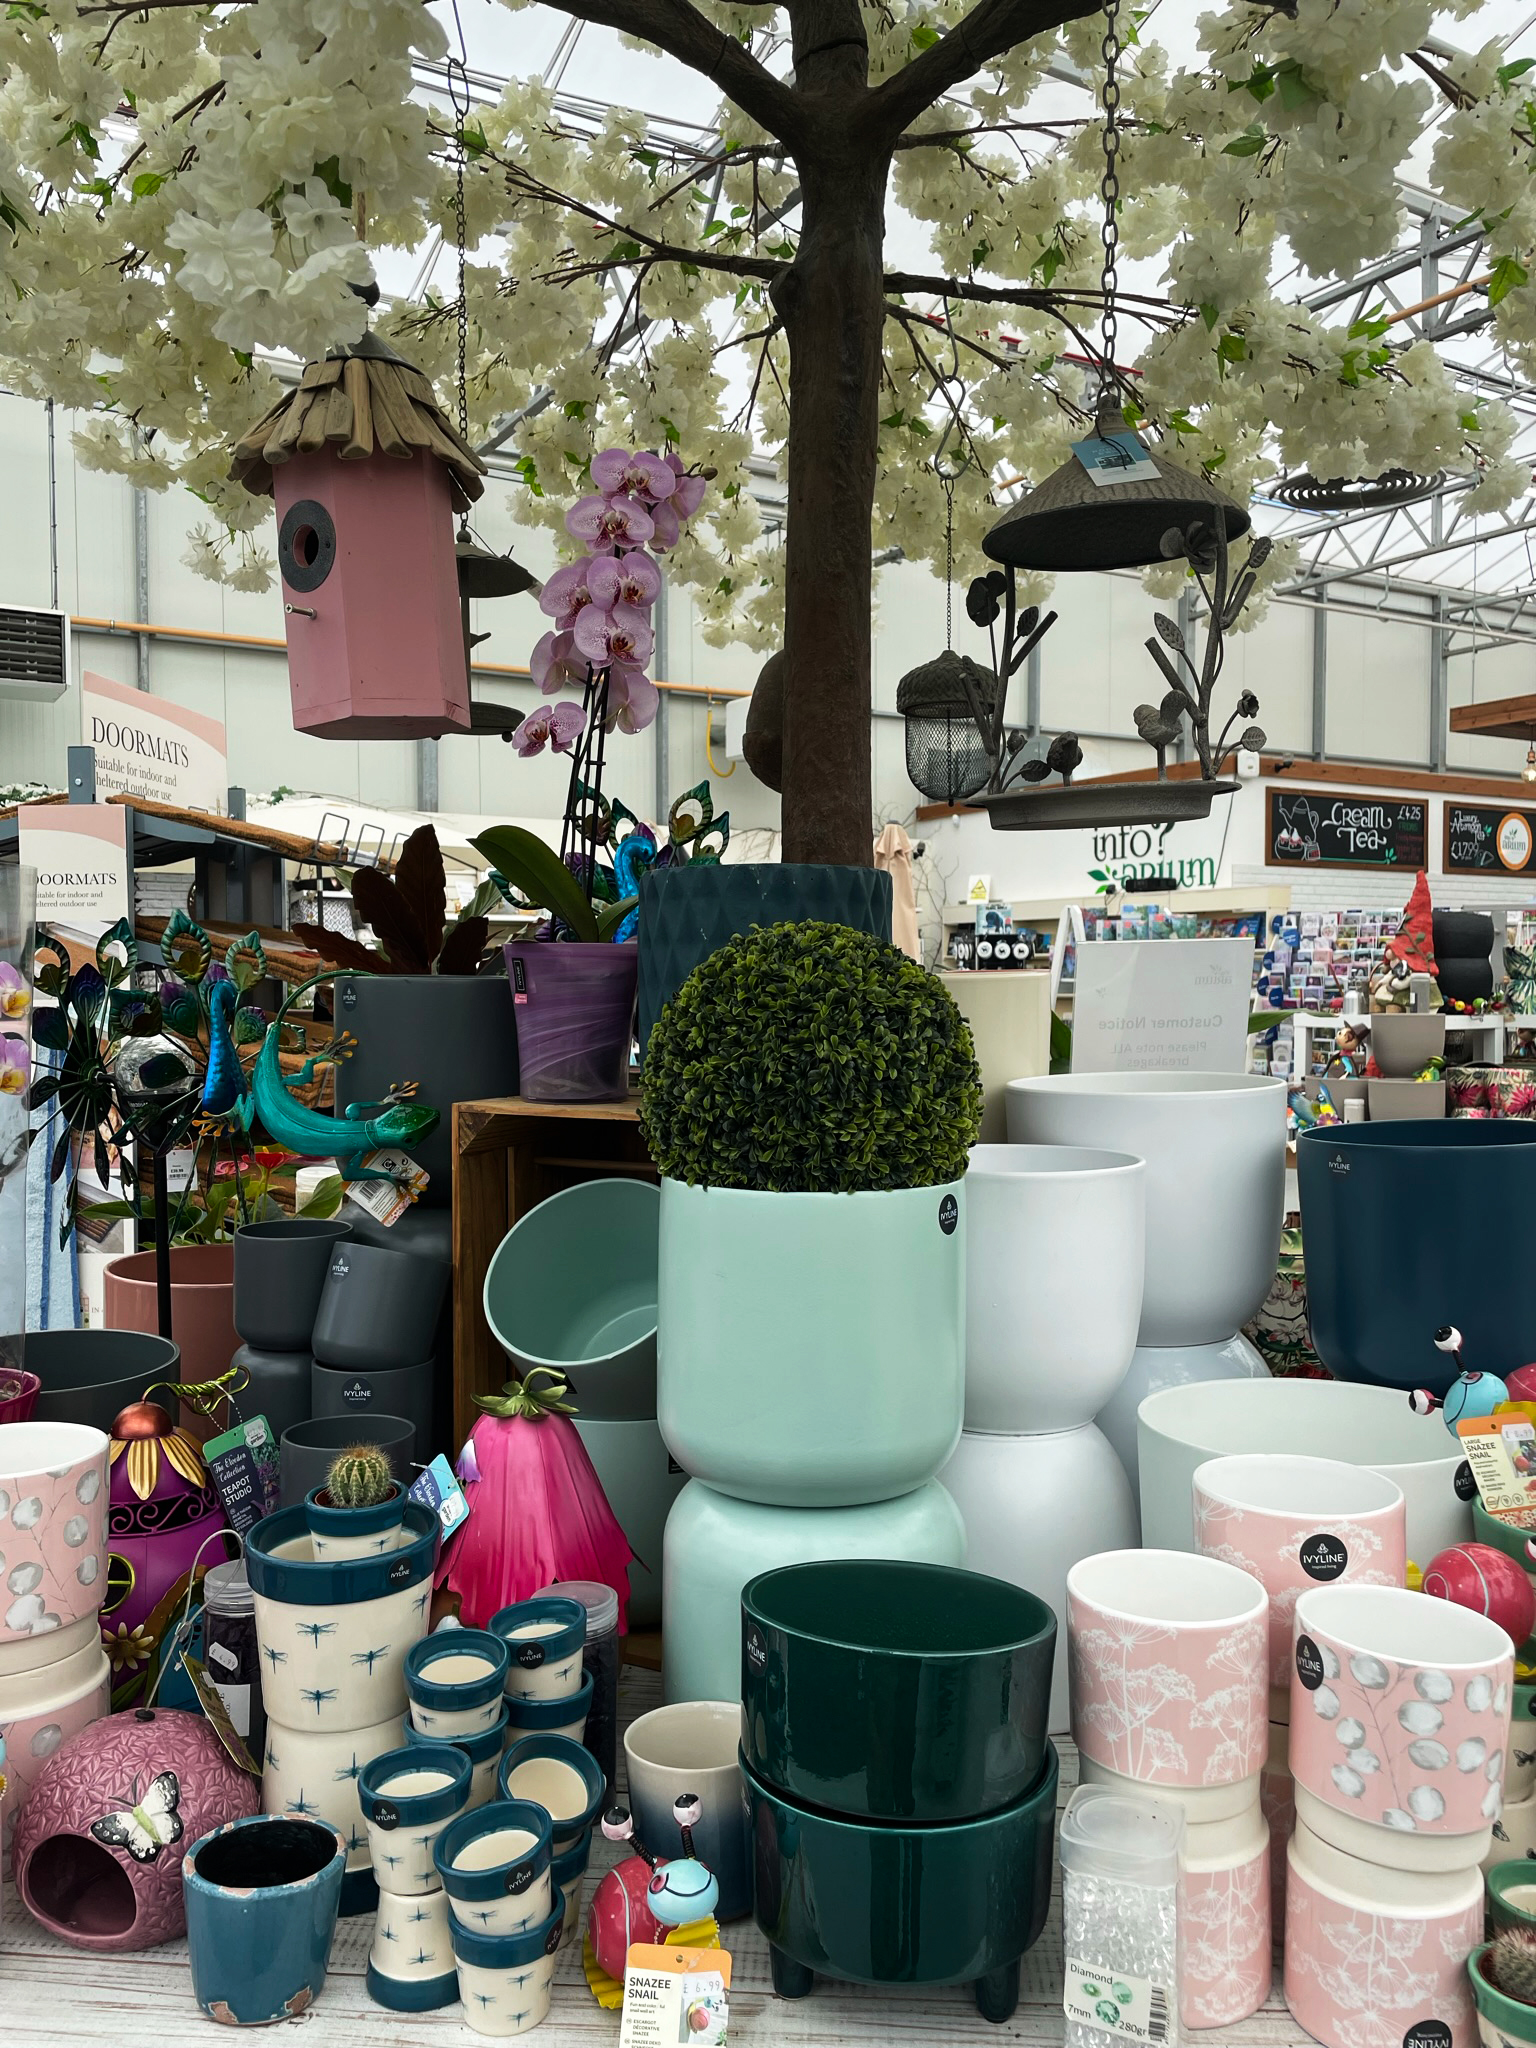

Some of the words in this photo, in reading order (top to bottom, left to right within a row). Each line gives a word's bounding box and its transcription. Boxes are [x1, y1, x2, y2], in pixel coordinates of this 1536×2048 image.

[91, 716, 189, 768] DOORMATS
[126, 762, 138, 777] for
[139, 765, 163, 783] indoor
[164, 774, 177, 787] and
[95, 772, 129, 792] heltered
[130, 783, 160, 798] outdoor
[161, 791, 172, 801] use
[1322, 802, 1392, 829] Cream
[1336, 827, 1387, 852] Tea
[36, 873, 117, 886] OORMATS
[36, 891, 55, 899] itable
[1329, 1161, 1350, 1170] IVYLINE
[940, 1209, 957, 1220] IVYLINE
[1466, 1442, 1496, 1452] SNAZEE
[1469, 1451, 1492, 1460] SNAIL
[221, 1475, 250, 1496] TEAPOT
[225, 1485, 253, 1506] STUDIO
[1303, 1554, 1344, 1563] IVYLINE
[391, 1569, 410, 1578] IVYLINE
[520, 1653, 542, 1661] IVYLINE
[747, 1641, 765, 1662] IVYLINE
[1297, 1656, 1321, 1672] IVYLINE
[376, 1813, 397, 1821] IVYLINE
[508, 1870, 532, 1890] IVYLINE
[1070, 1963, 1113, 1985] Diamond
[629, 1976, 671, 1989] SNAZEE
[695, 1980, 721, 1993] 6.99
[628, 1988, 659, 2000] SNAIL
[1068, 2003, 1091, 2019] 7mm
[1119, 2020, 1147, 2036] 280gr
